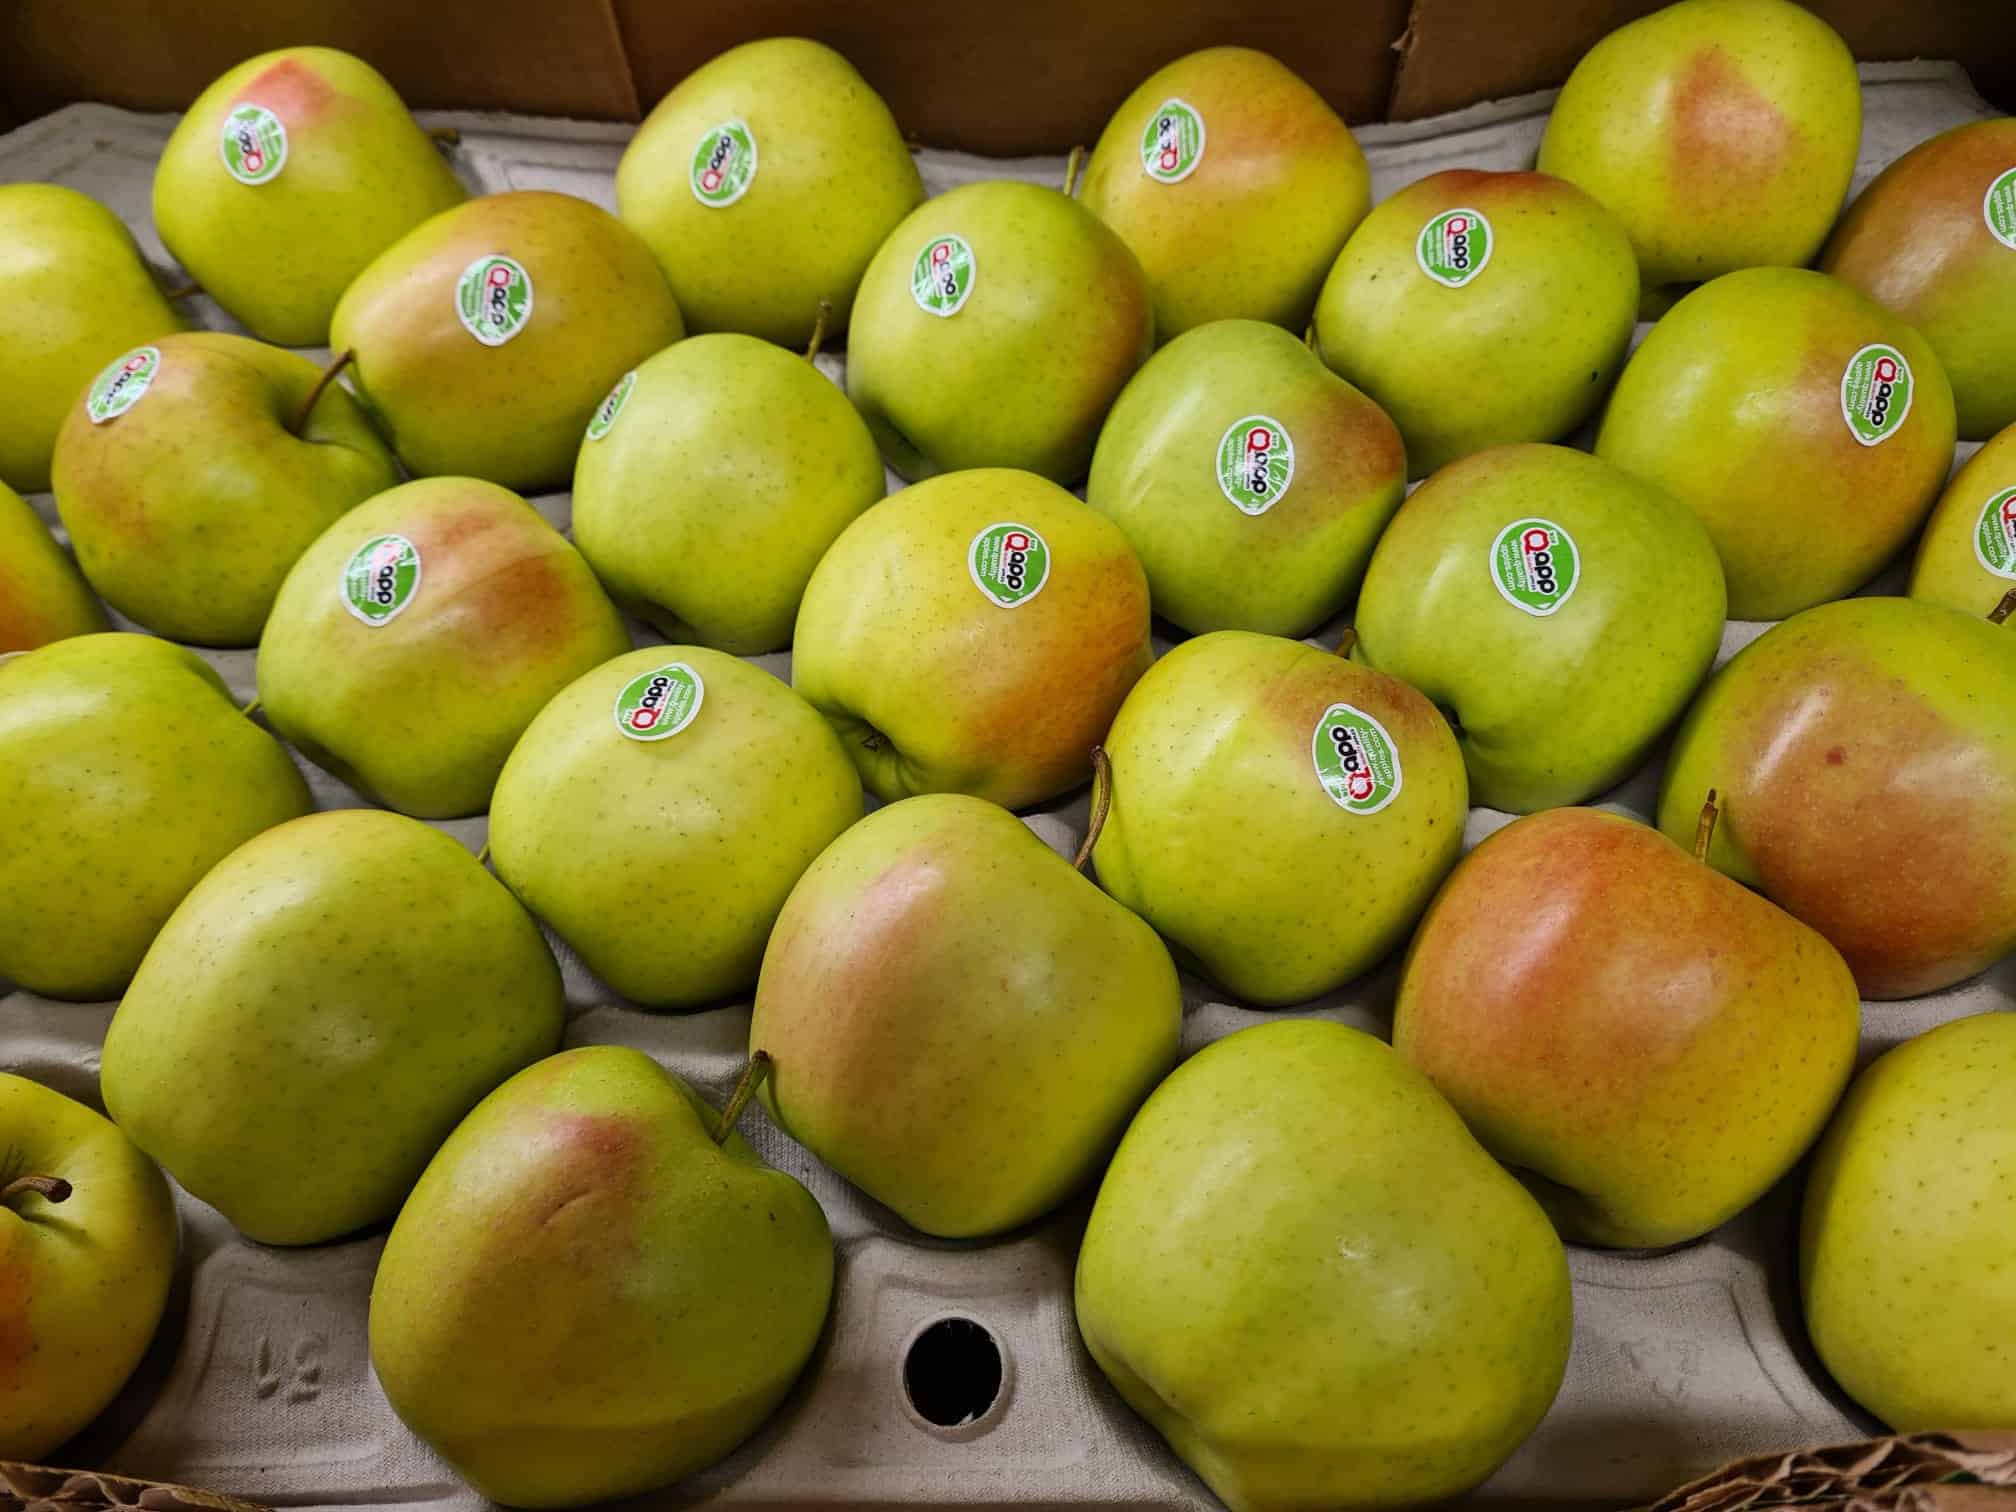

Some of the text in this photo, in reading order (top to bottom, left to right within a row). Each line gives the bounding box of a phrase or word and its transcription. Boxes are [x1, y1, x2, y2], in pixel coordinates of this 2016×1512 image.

[1446, 217, 1467, 268] Qapp
[1872, 358, 1898, 425] Qapp
[1247, 428, 1270, 492] Qapp
[1004, 532, 1029, 589] Qapp
[1524, 529, 1554, 592] Qapp
[629, 678, 666, 727] Qapp
[1332, 727, 1372, 800] Qapp
